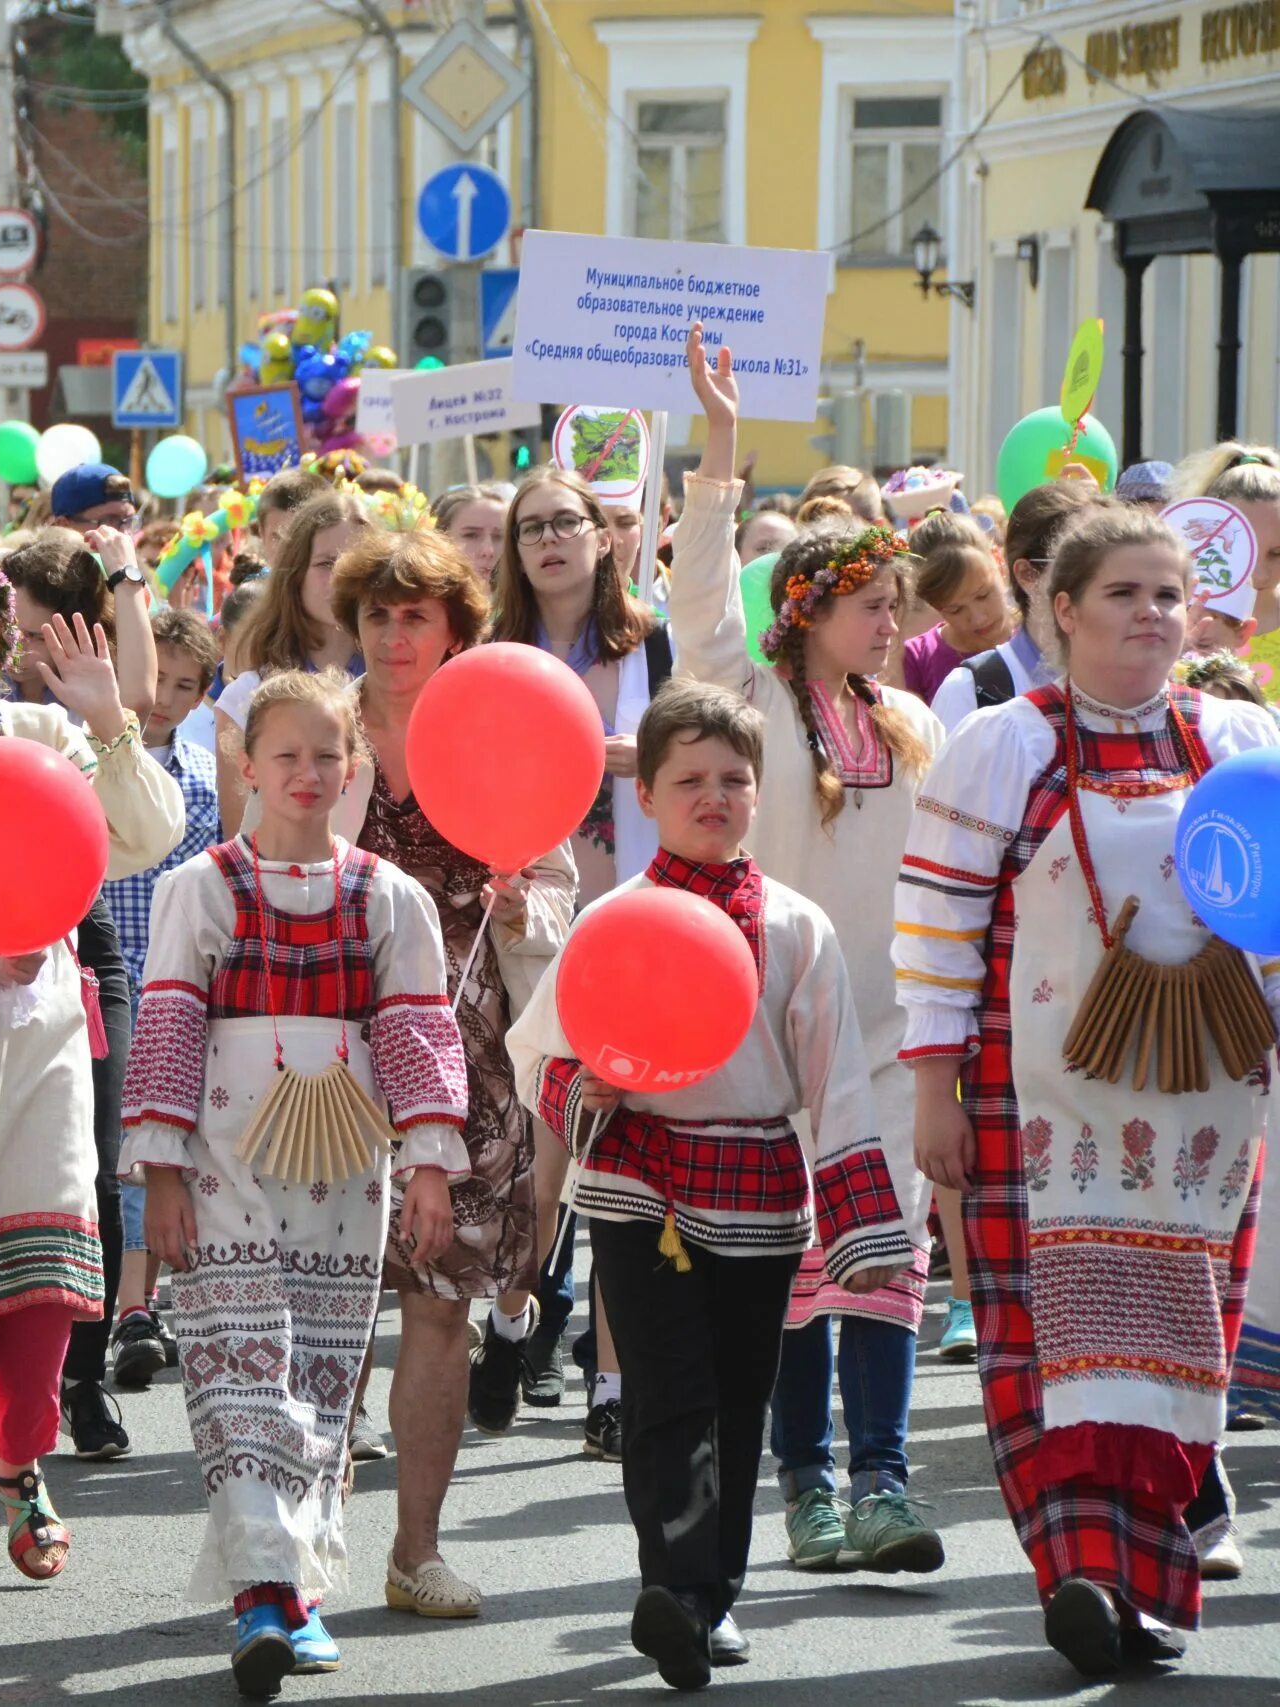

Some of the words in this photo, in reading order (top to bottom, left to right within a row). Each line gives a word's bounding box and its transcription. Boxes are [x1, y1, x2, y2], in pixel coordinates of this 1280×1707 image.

[586, 268, 684, 291] Муниципальное
[688, 275, 760, 297] бюджетное
[577, 292, 684, 316] образовательное
[687, 304, 765, 323] учреждение
[614, 324, 657, 342] города
[661, 324, 723, 345] Костмы
[525, 339, 583, 360] «Средняя
[773, 358, 809, 376] №31»
[428, 396, 468, 411] Лицей
[474, 388, 503, 403] №32
[444, 407, 506, 426] Кострома
